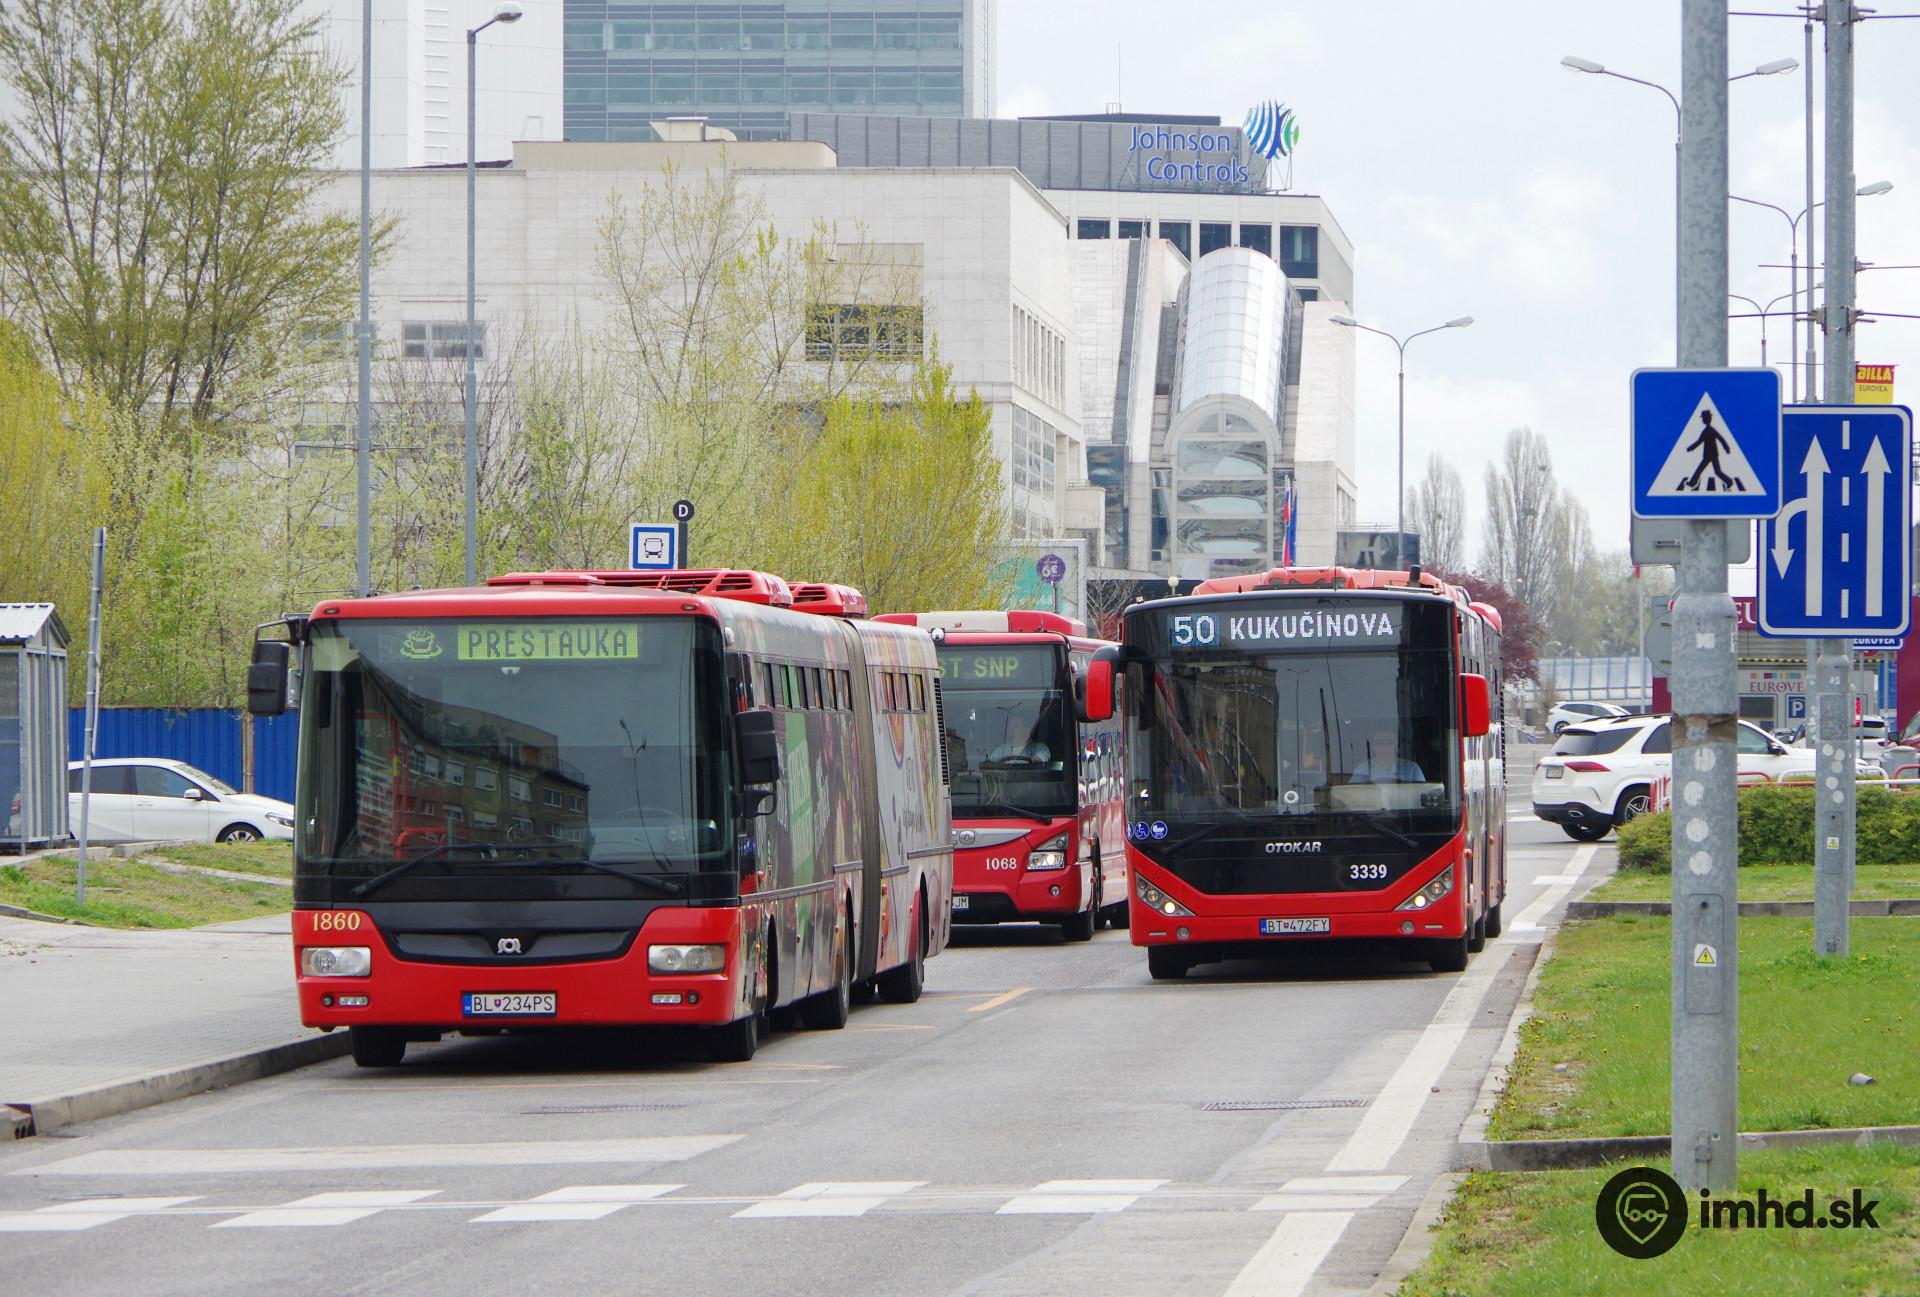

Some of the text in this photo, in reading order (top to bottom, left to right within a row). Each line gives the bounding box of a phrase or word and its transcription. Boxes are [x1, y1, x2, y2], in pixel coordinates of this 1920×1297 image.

[1129, 126, 1230, 152] Johnson
[1146, 156, 1249, 183] Controls
[1857, 367, 1892, 381] BILLA
[1859, 384, 1888, 392] EUROVEA
[678, 504, 688, 517] D
[1174, 611, 1394, 645] 50 KUKUČÍNOVA
[974, 656, 1019, 678] SNP
[1750, 682, 1804, 693] EUROVE
[1265, 841, 1322, 854] OTOKAR
[985, 857, 1017, 871] 1068
[1350, 864, 1388, 880] 3339
[313, 912, 361, 932] 1860
